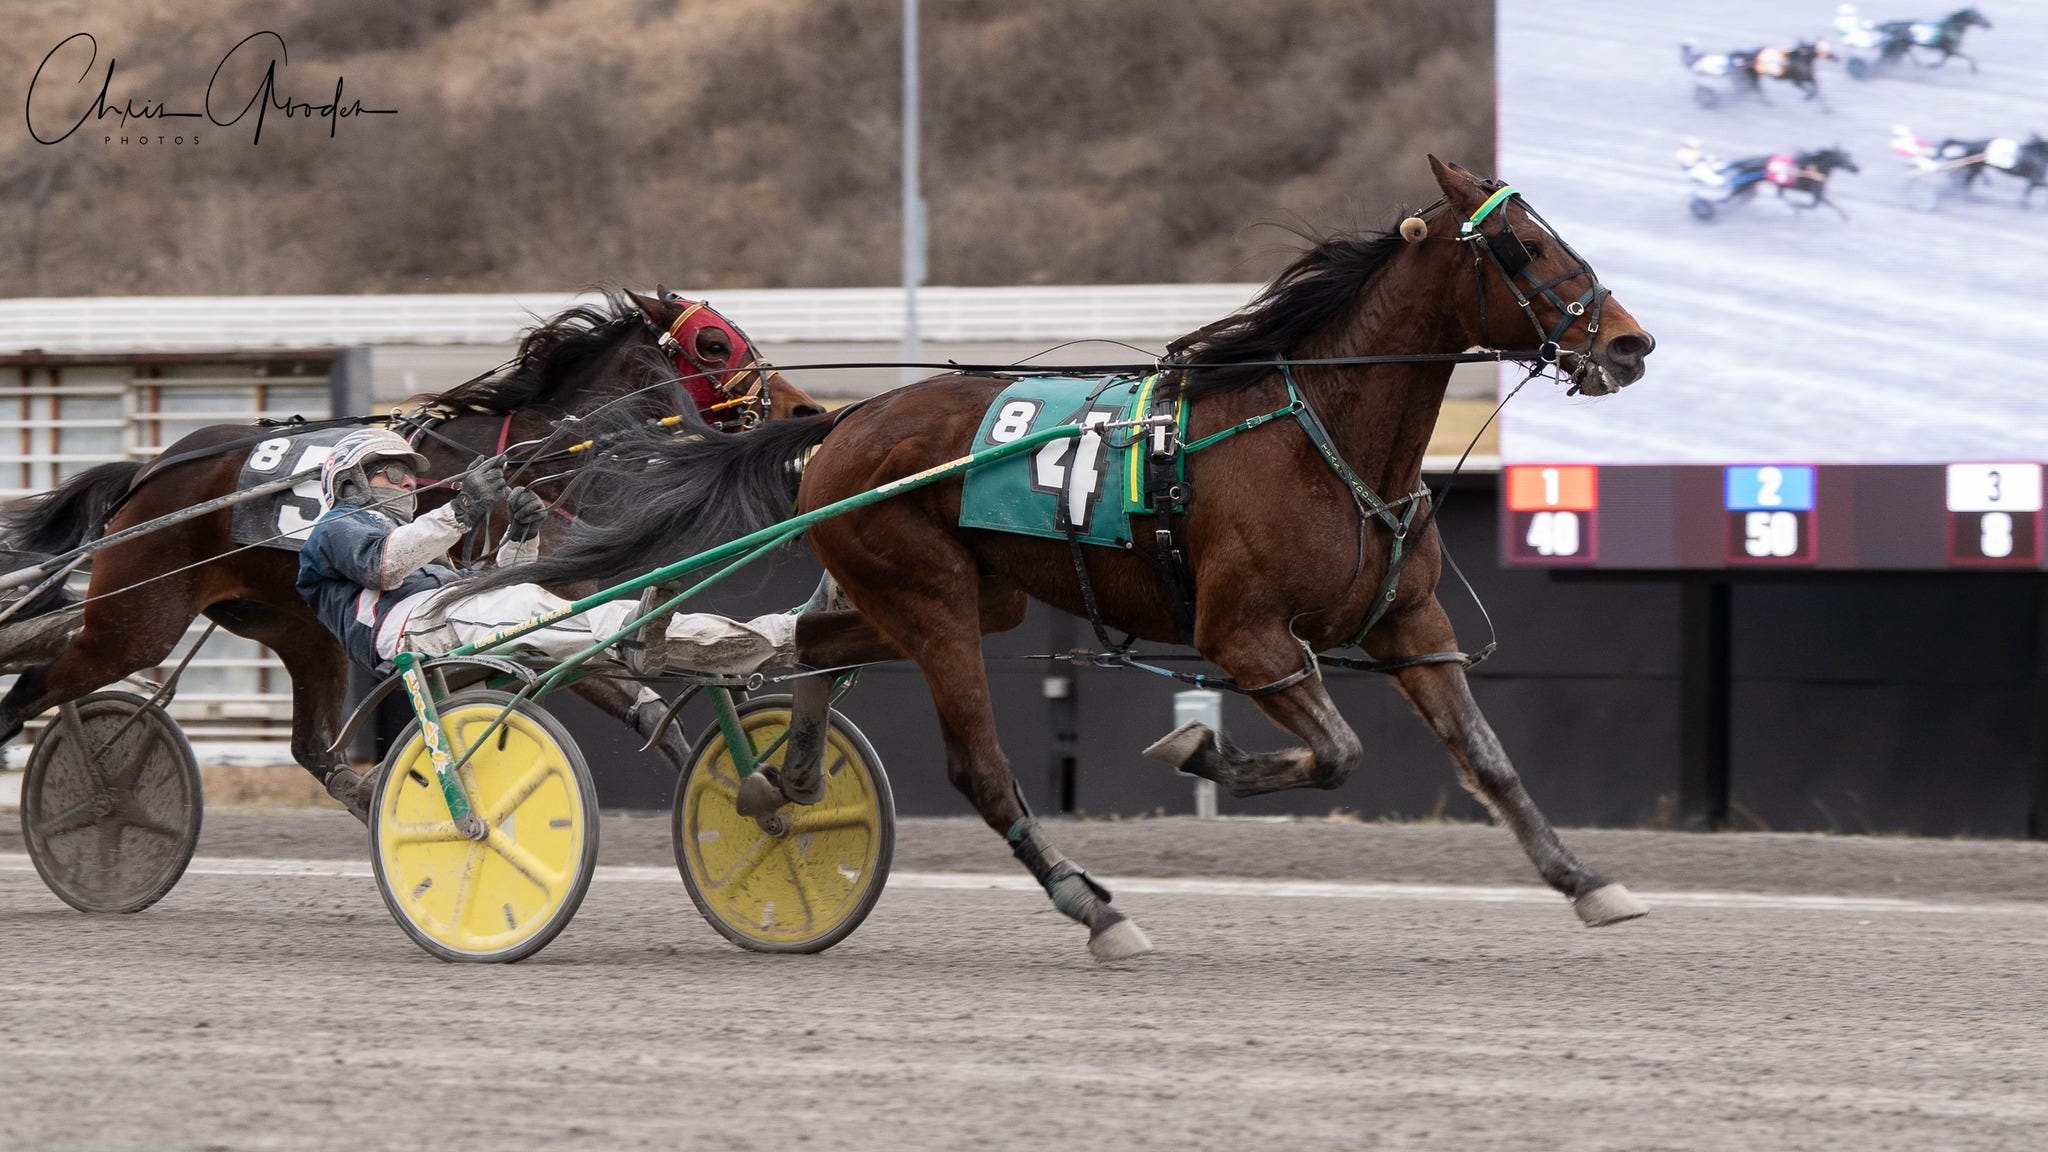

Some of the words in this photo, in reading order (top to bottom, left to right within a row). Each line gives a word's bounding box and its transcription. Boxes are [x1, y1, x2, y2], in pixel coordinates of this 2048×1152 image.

[992, 401, 1036, 443] 8
[250, 438, 291, 470] 8
[1036, 411, 1112, 526] 4
[277, 445, 333, 541] 5
[1542, 468, 1559, 506] 1
[1757, 466, 1783, 506] 2
[1988, 470, 2001, 502] 3
[1526, 511, 1579, 556] 40
[1745, 511, 1798, 557] 50
[1981, 512, 2013, 557] 8
